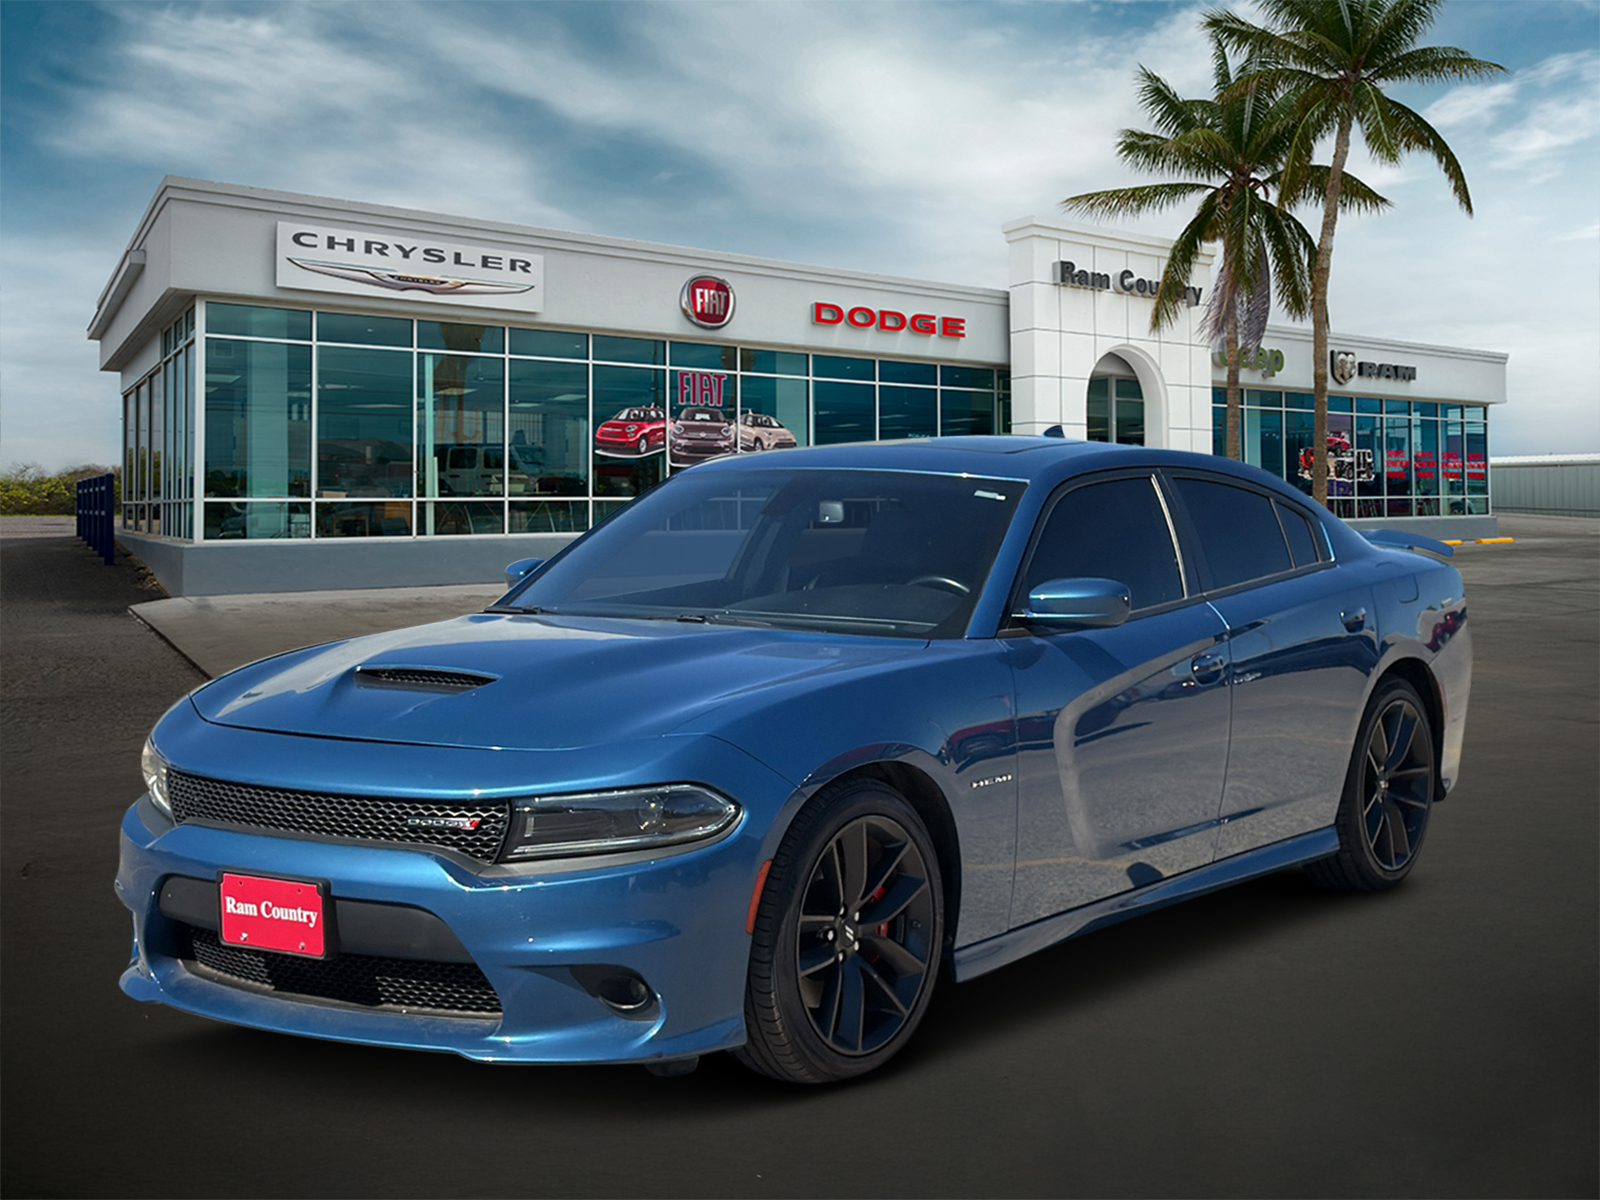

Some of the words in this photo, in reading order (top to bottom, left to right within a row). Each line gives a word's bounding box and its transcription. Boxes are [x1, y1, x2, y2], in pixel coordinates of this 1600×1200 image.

[291, 231, 533, 274] CHRYSLER
[1052, 260, 1110, 291] Ram
[1113, 269, 1203, 308] Coury
[695, 288, 727, 315] FIAT
[812, 301, 966, 338] DODGE
[1358, 361, 1416, 380] RAM
[678, 371, 727, 406] FIAT
[971, 774, 1012, 788] HEMI
[225, 896, 258, 916] Ram
[260, 901, 318, 928] Country
